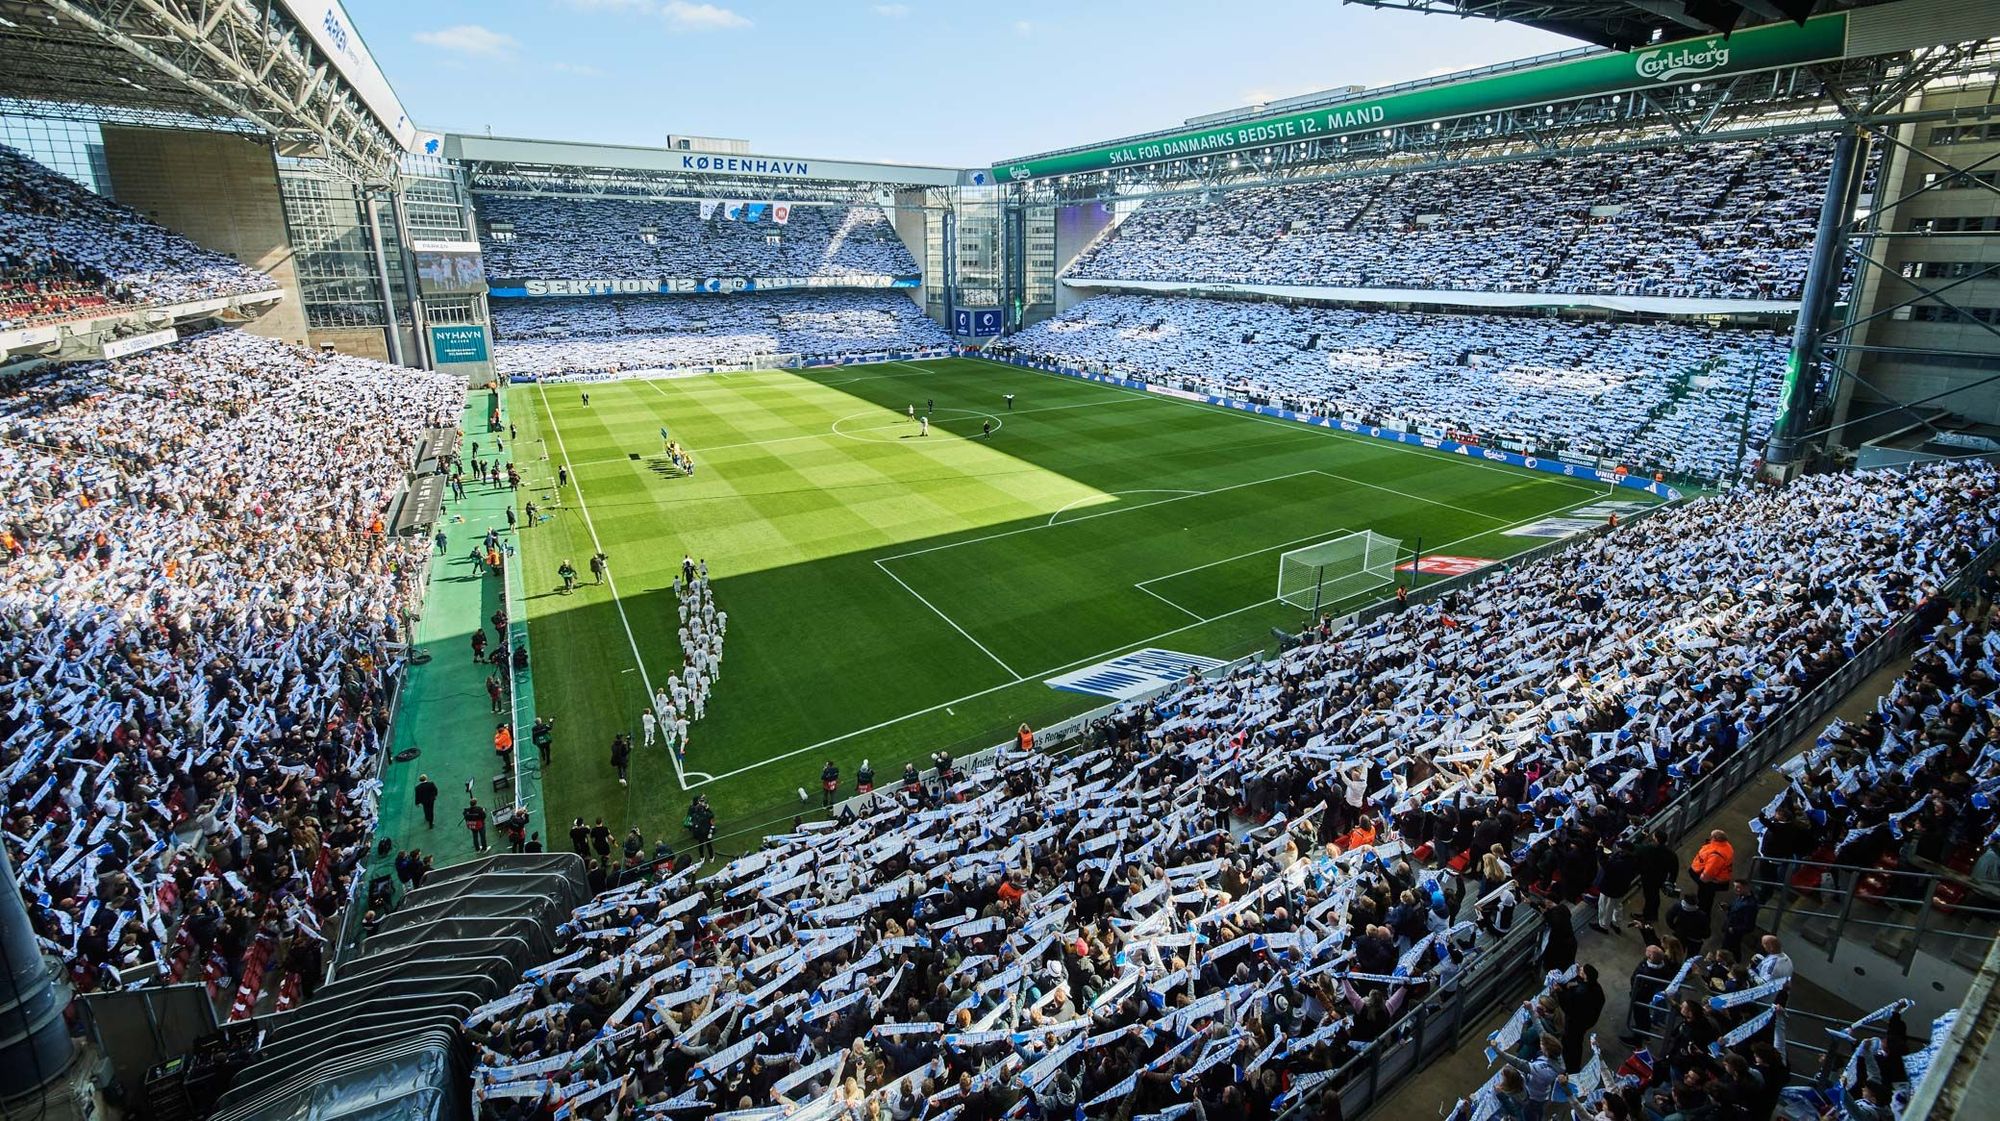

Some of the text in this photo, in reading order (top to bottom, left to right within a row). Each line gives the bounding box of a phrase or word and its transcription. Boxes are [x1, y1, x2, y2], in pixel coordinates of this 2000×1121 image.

[323, 9, 347, 53] PARKEN
[1635, 47, 1729, 80] Carlsberg
[1138, 146, 1161, 159] FOR
[1163, 132, 1235, 156] DANMARKS
[1238, 121, 1295, 144] BEDSTE
[1299, 118, 1322, 133] 12.
[1327, 105, 1384, 130] MAND
[683, 156, 808, 175] KØBENHAVN
[525, 278, 698, 296] SEKTION 12
[436, 331, 481, 340] NYHAVN
